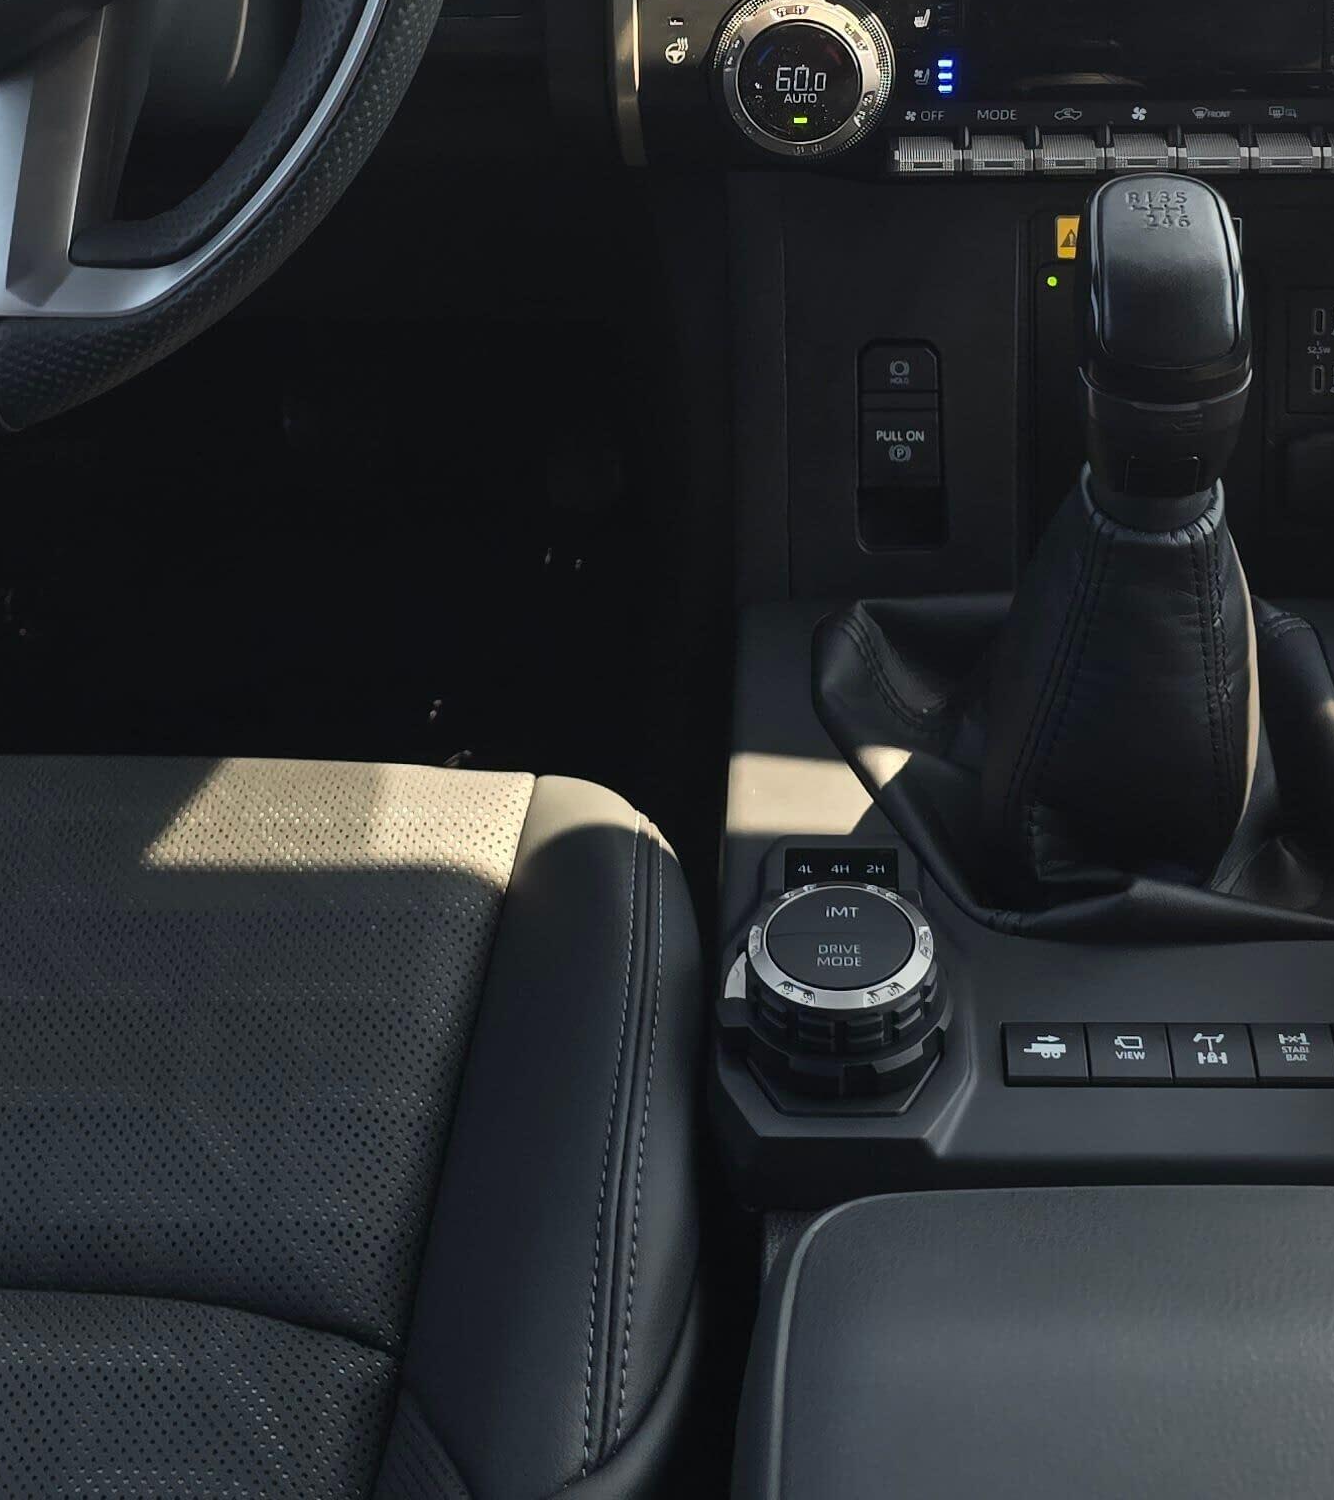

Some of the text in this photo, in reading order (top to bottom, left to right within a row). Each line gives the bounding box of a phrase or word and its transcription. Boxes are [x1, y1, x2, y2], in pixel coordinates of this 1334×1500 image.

[775, 66, 827, 92] 60.0
[783, 93, 818, 104] AUTO
[920, 110, 945, 122] OFF
[976, 109, 1018, 121] MODE
[1206, 110, 1232, 118] FRONT
[876, 429, 925, 442] PULL ON
[797, 864, 813, 875] 4L
[830, 864, 850, 874] 4H
[866, 864, 886, 874] 2H
[825, 905, 860, 919] iMT
[818, 943, 861, 955] DRIVE
[816, 956, 862, 967] MODE
[1115, 1050, 1146, 1061] VIEW
[1285, 1053, 1308, 1062] BAR
